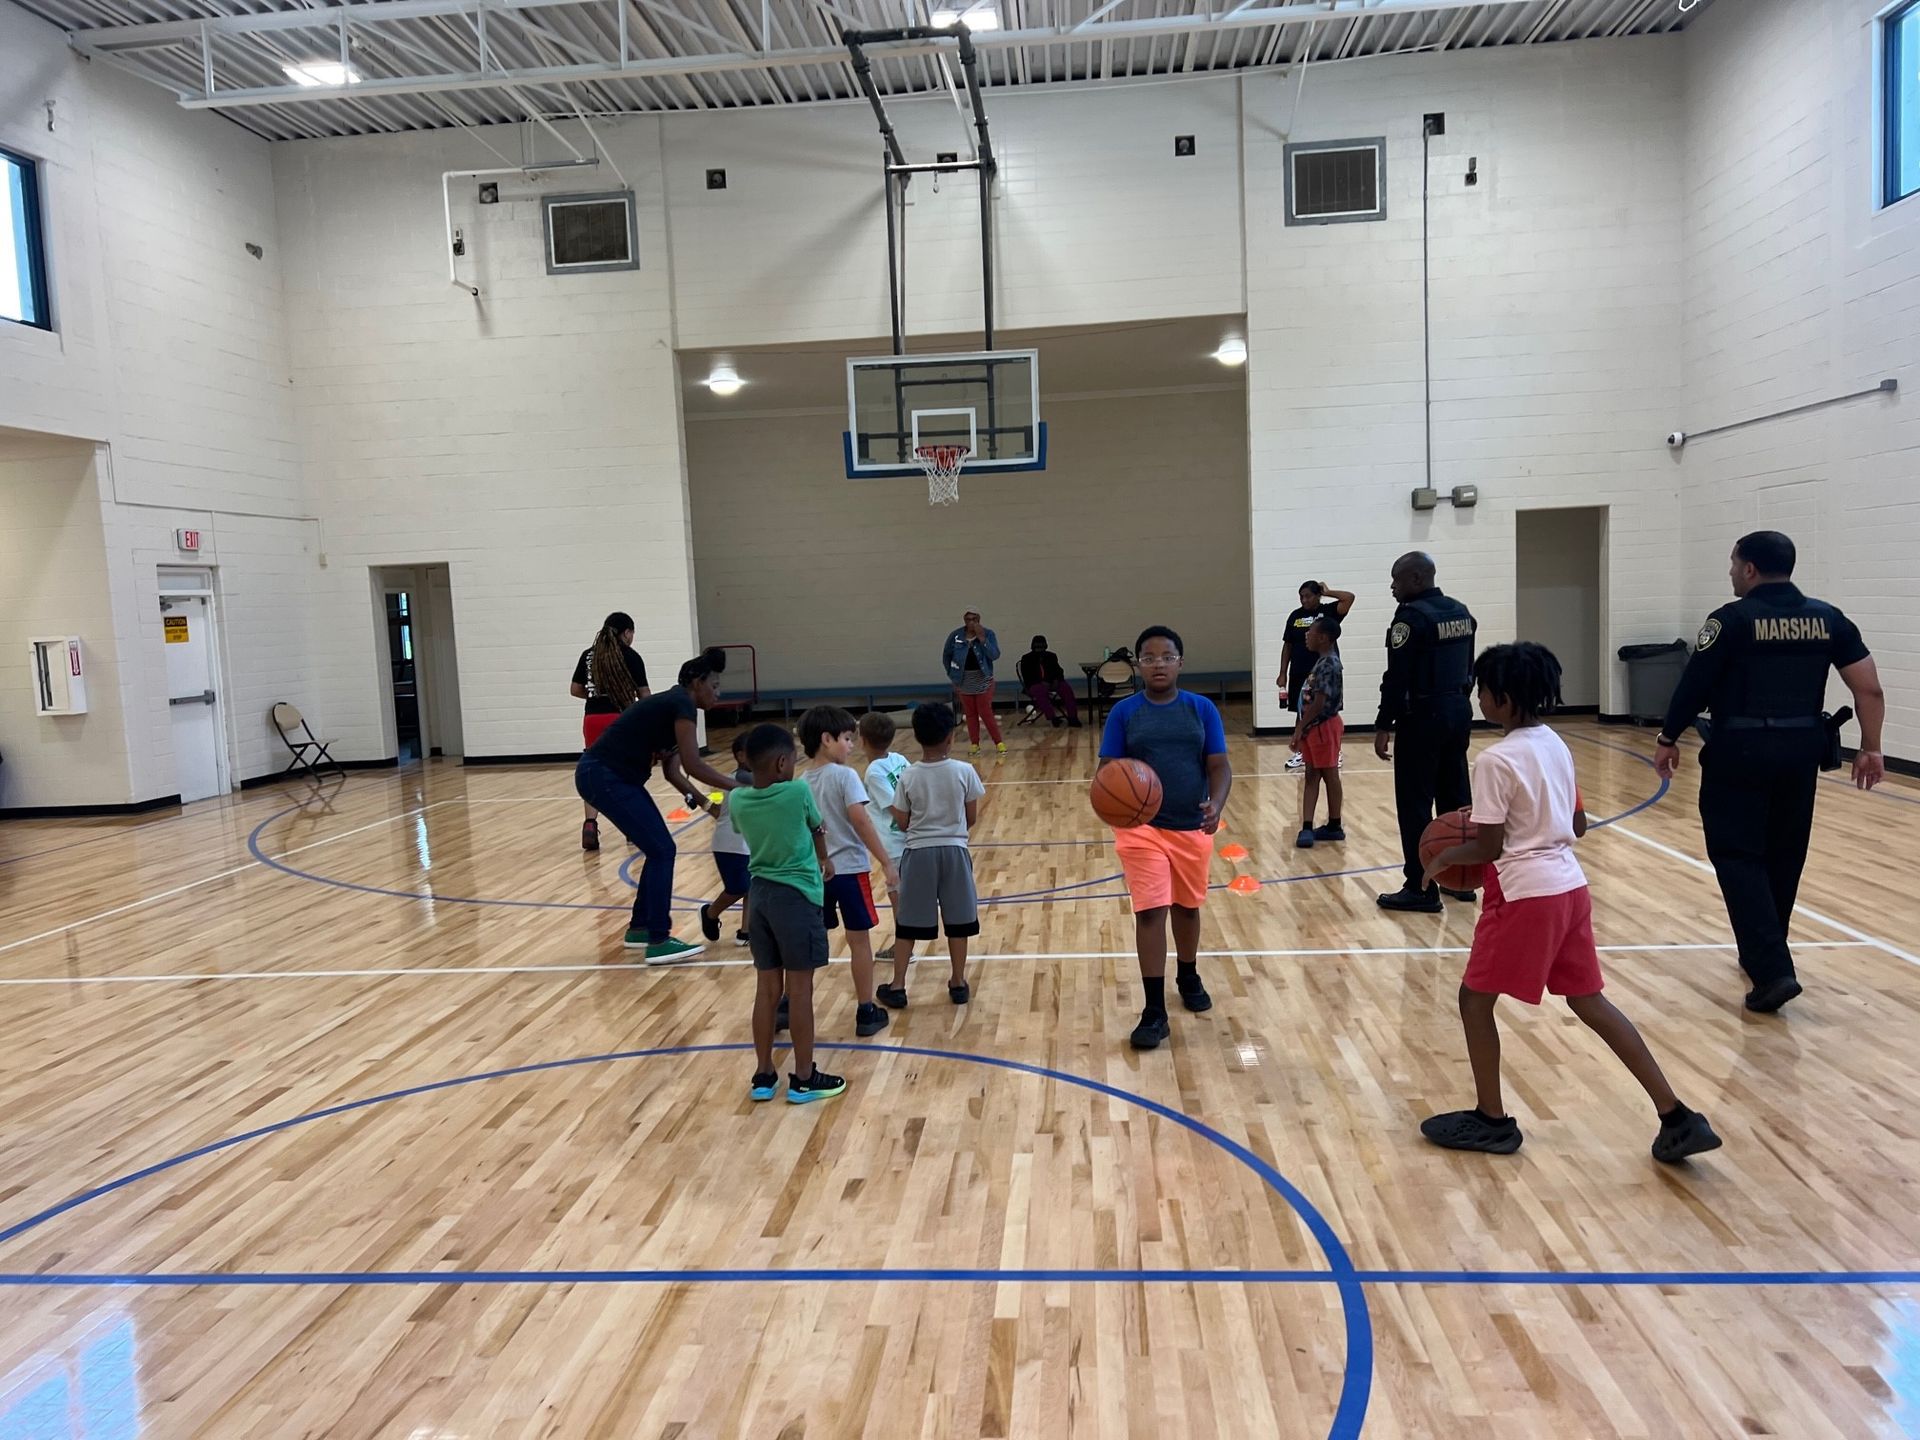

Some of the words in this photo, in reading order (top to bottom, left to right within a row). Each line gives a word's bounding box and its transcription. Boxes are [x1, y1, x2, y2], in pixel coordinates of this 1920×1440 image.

[185, 531, 199, 548] EXIT
[165, 618, 186, 626] CAUTION
[1437, 618, 1473, 640] MARSHAL
[1754, 617, 1830, 641] MARSHAL
